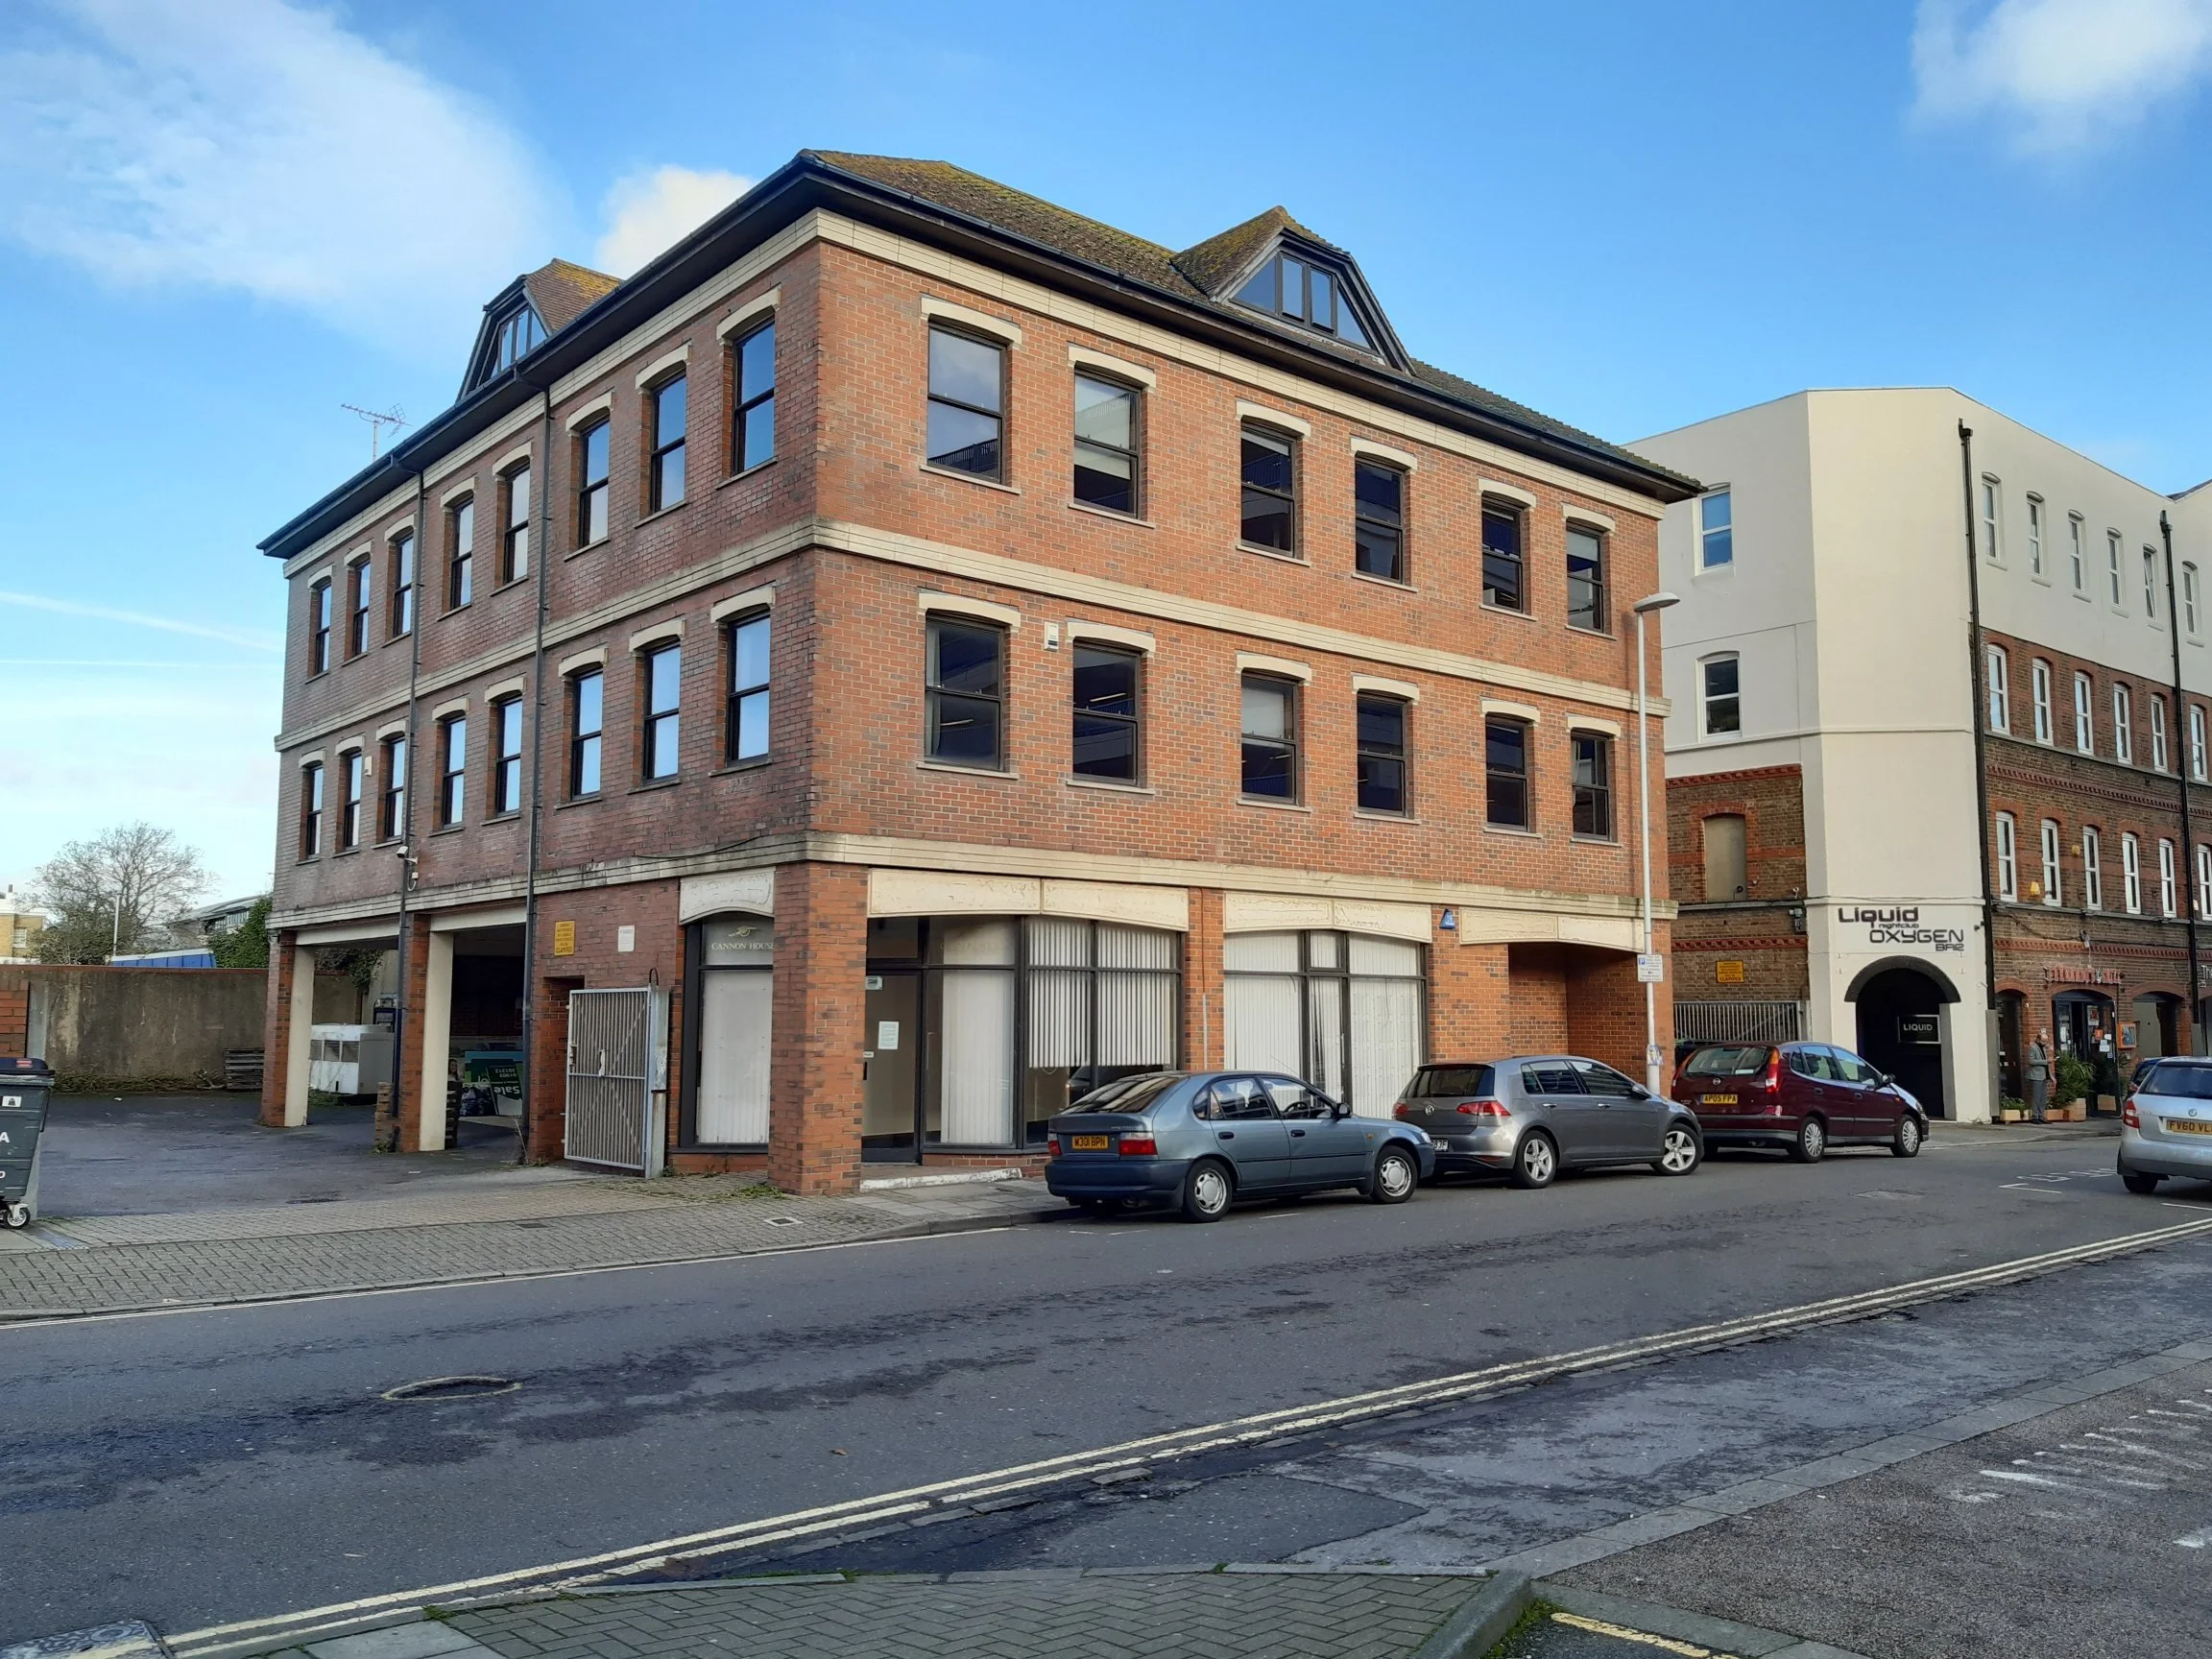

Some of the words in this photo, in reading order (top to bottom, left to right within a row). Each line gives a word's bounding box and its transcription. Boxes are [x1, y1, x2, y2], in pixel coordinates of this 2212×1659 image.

[1838, 906, 1919, 928] Liquid
[1869, 929, 1964, 943] OXYGEN
[711, 942, 747, 950] CANNON
[1936, 943, 1965, 951] BAR
[493, 1086, 520, 1094] Sale
